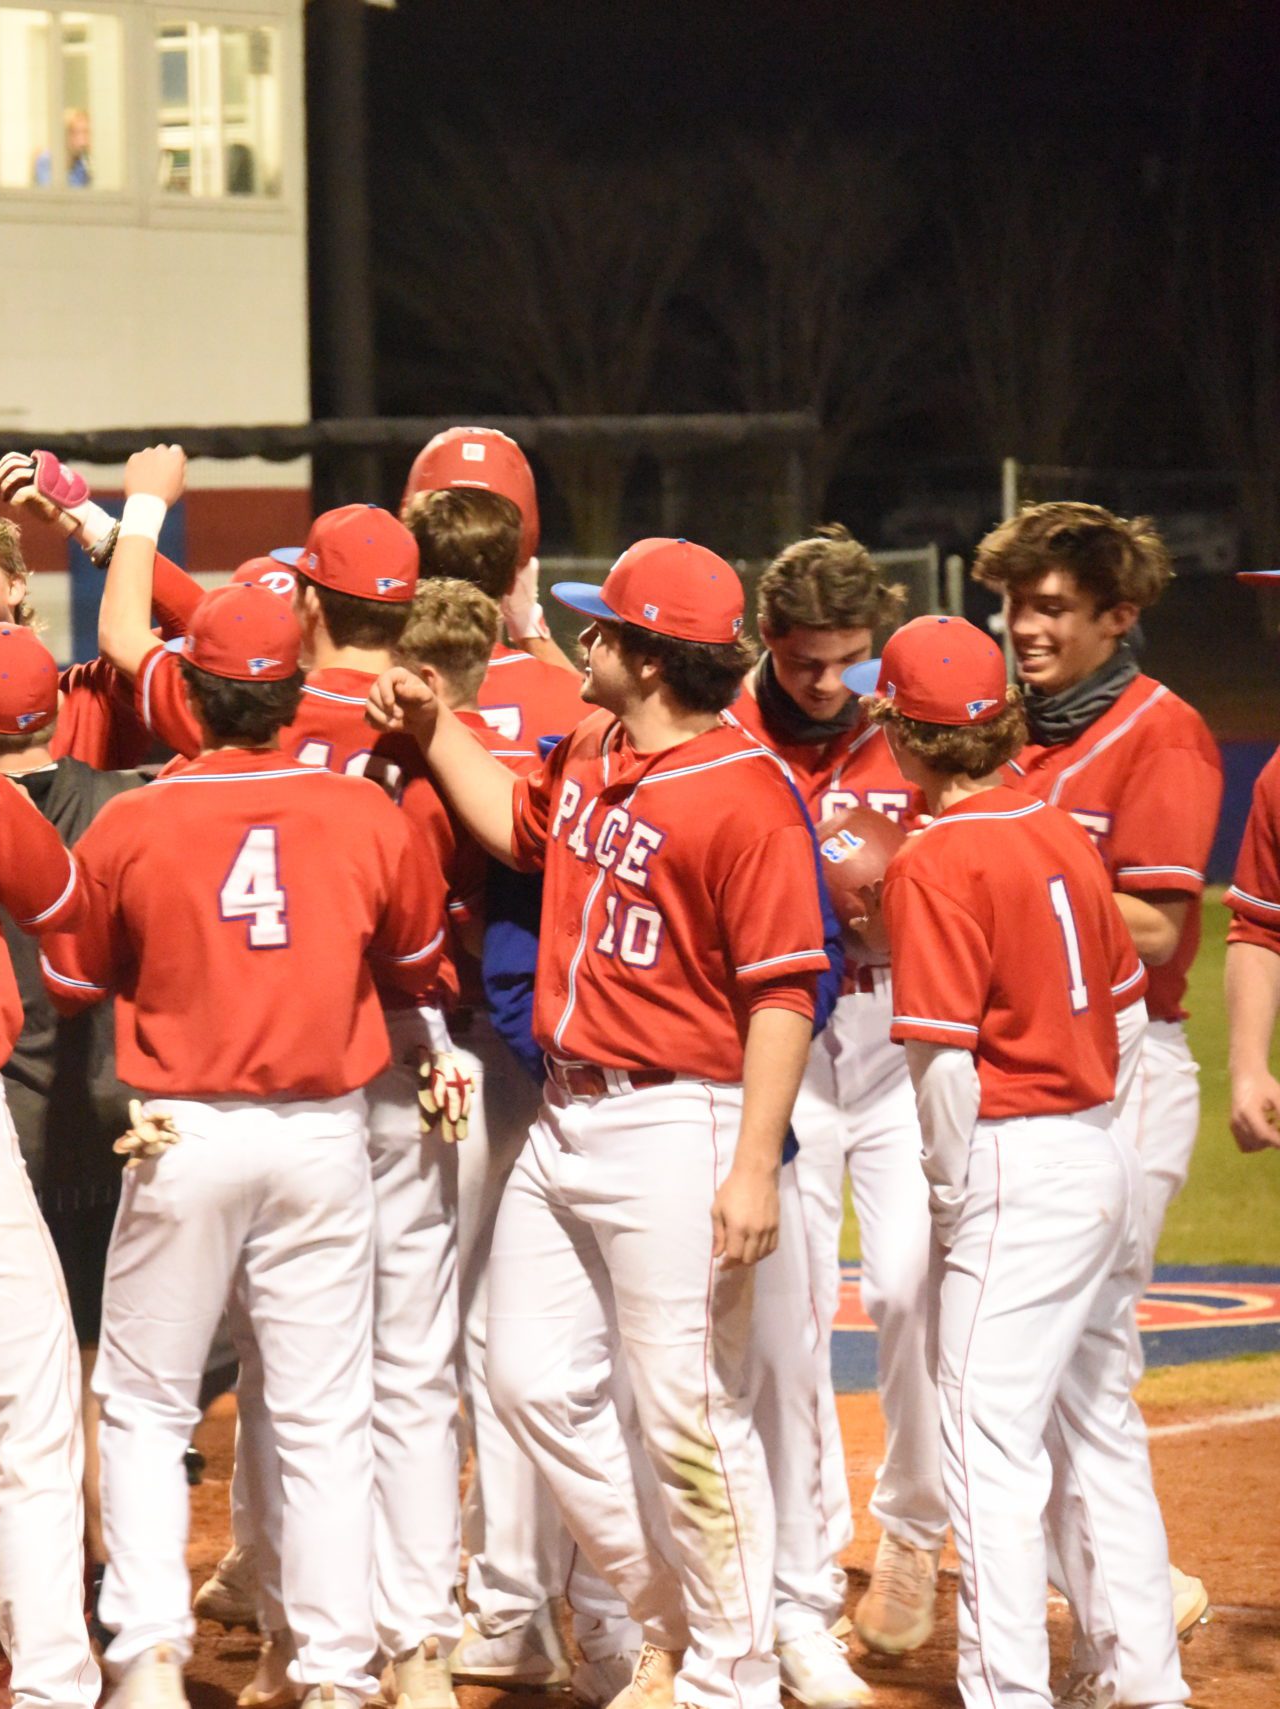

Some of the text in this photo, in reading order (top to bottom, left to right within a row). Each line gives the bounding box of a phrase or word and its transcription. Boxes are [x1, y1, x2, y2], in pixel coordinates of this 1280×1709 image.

[218, 825, 290, 950] 4
[551, 777, 667, 890] PACE
[595, 892, 666, 970] 10
[1047, 874, 1089, 1016] 1
